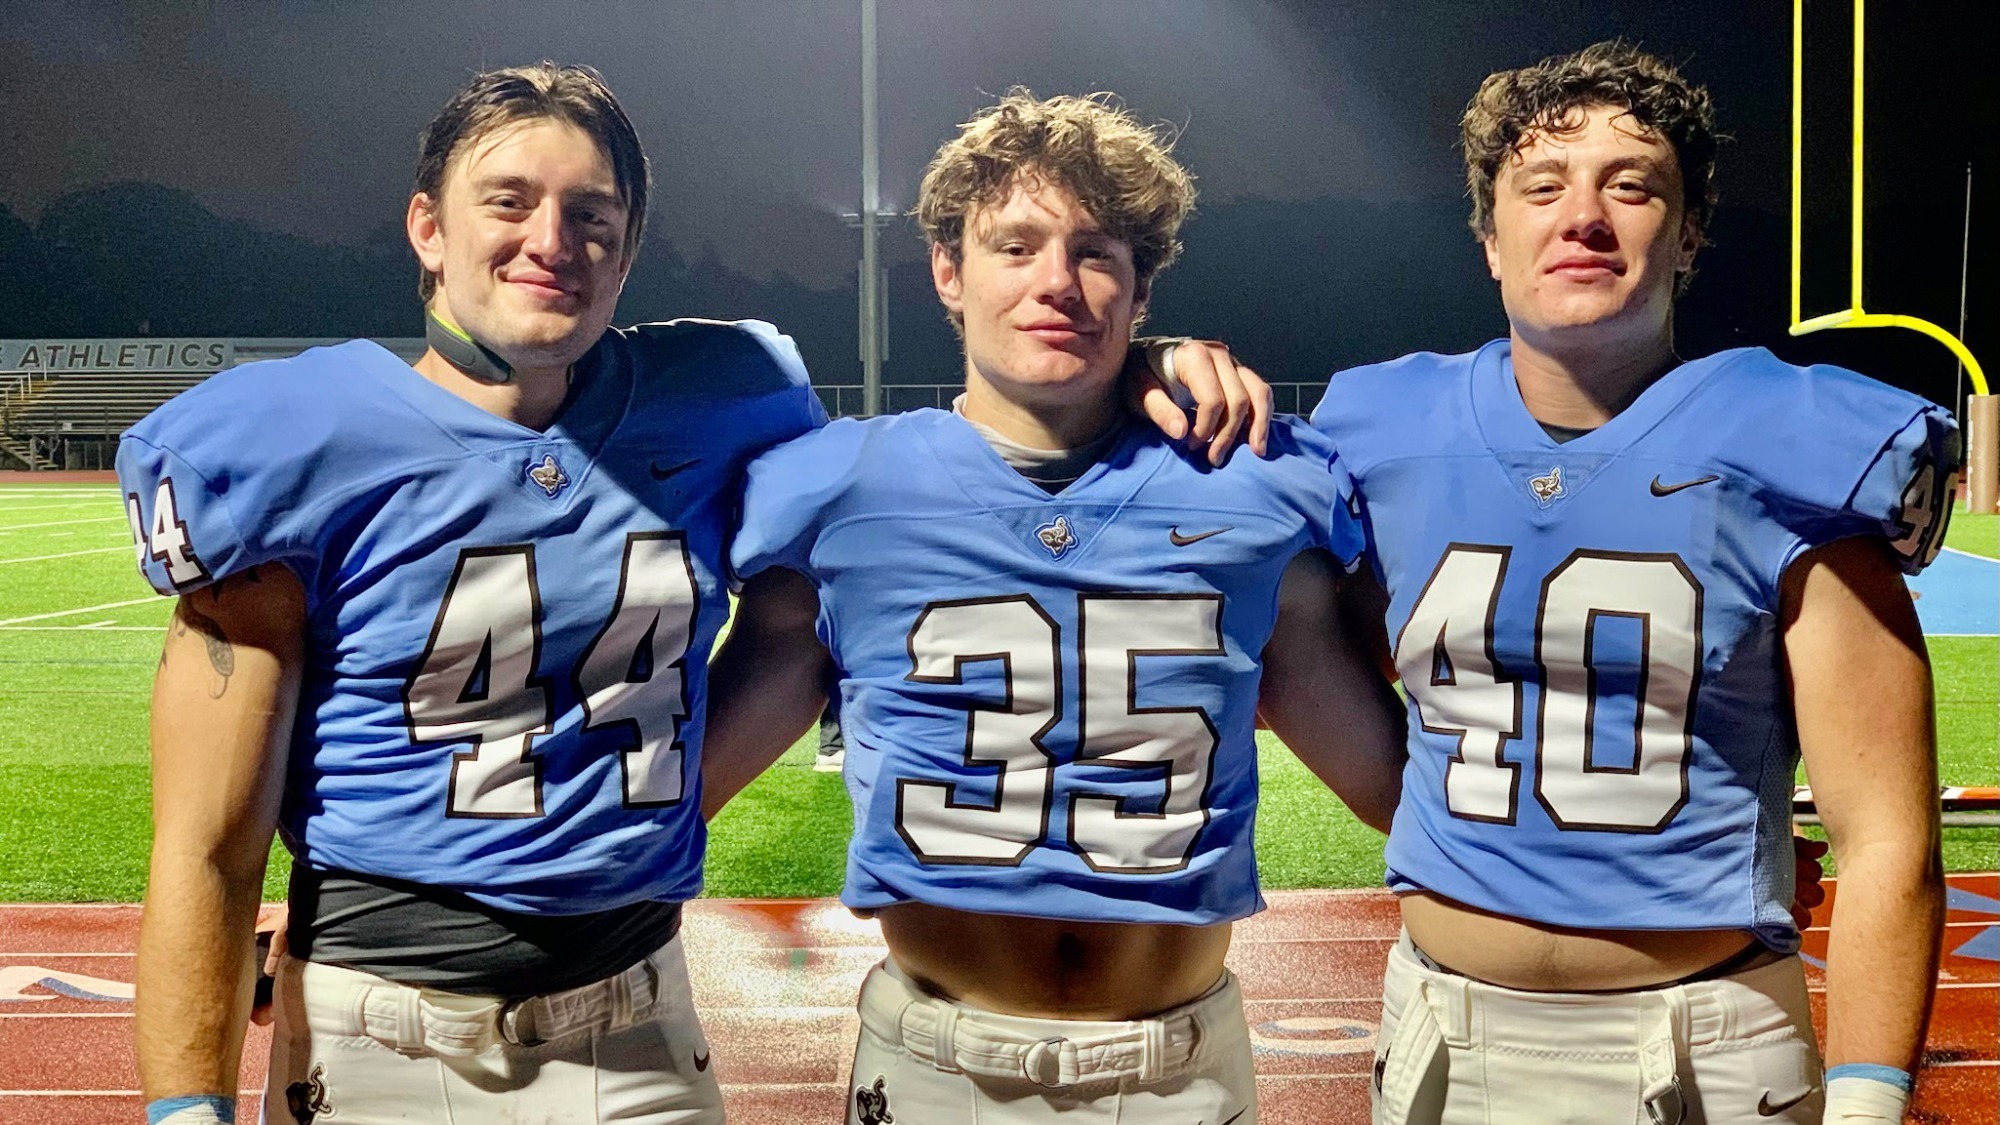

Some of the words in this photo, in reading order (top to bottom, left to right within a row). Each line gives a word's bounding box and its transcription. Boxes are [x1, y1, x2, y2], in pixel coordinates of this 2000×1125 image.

[18, 343, 226, 369] ATHLETICS
[402, 530, 700, 820] 44
[894, 592, 1228, 875] 35
[1394, 541, 1705, 835] 40
